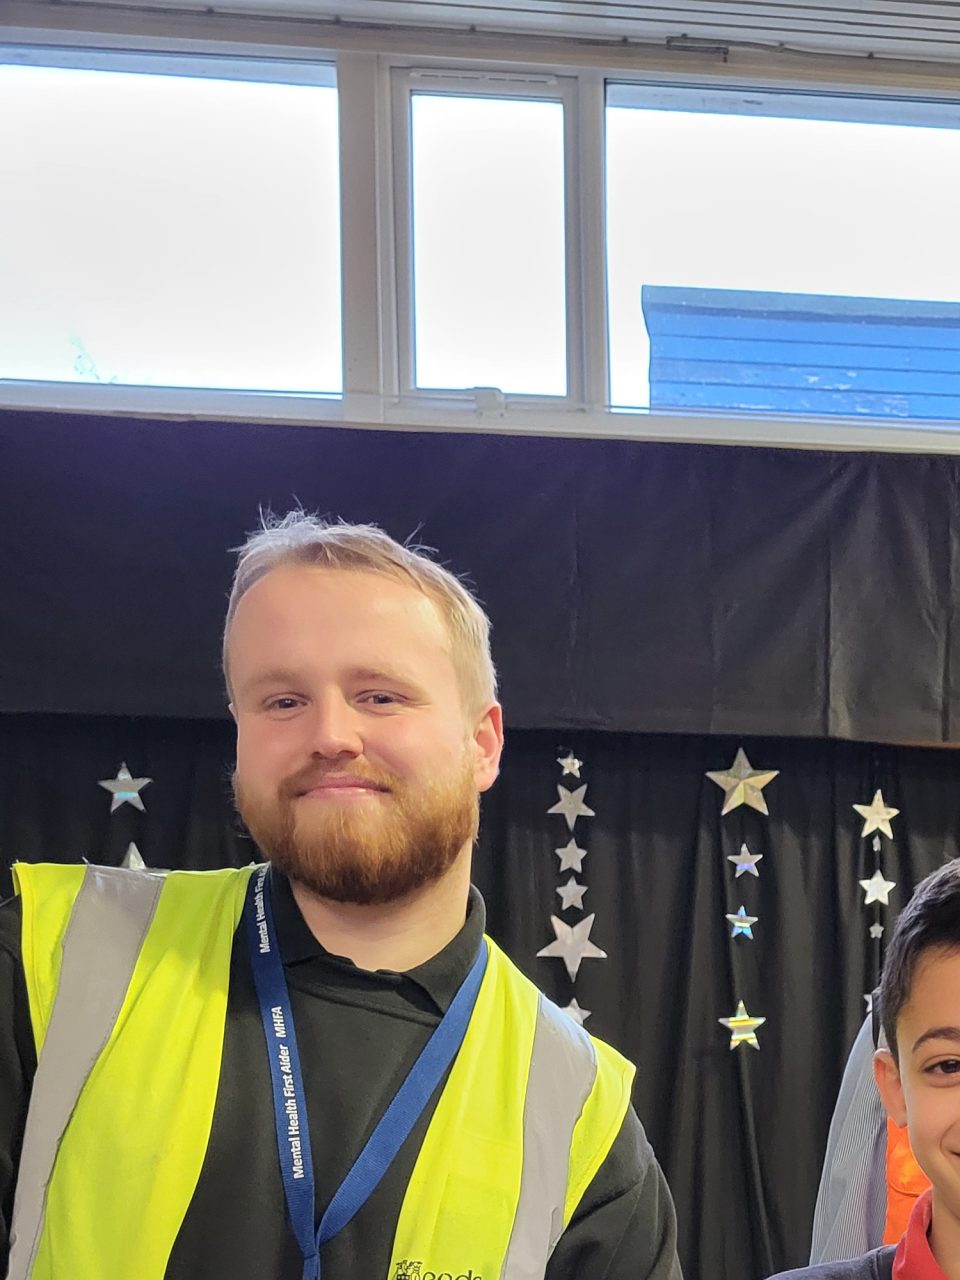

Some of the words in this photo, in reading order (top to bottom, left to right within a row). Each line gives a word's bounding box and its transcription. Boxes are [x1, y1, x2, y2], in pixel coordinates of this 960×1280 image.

[254, 892, 266, 921] Health
[256, 920, 271, 954] Mental
[271, 1005, 287, 1038] MHFA
[278, 1044, 292, 1073] Aider
[283, 1074, 295, 1097] First
[284, 1099, 300, 1136] Health
[287, 1137, 305, 1179] Mental
